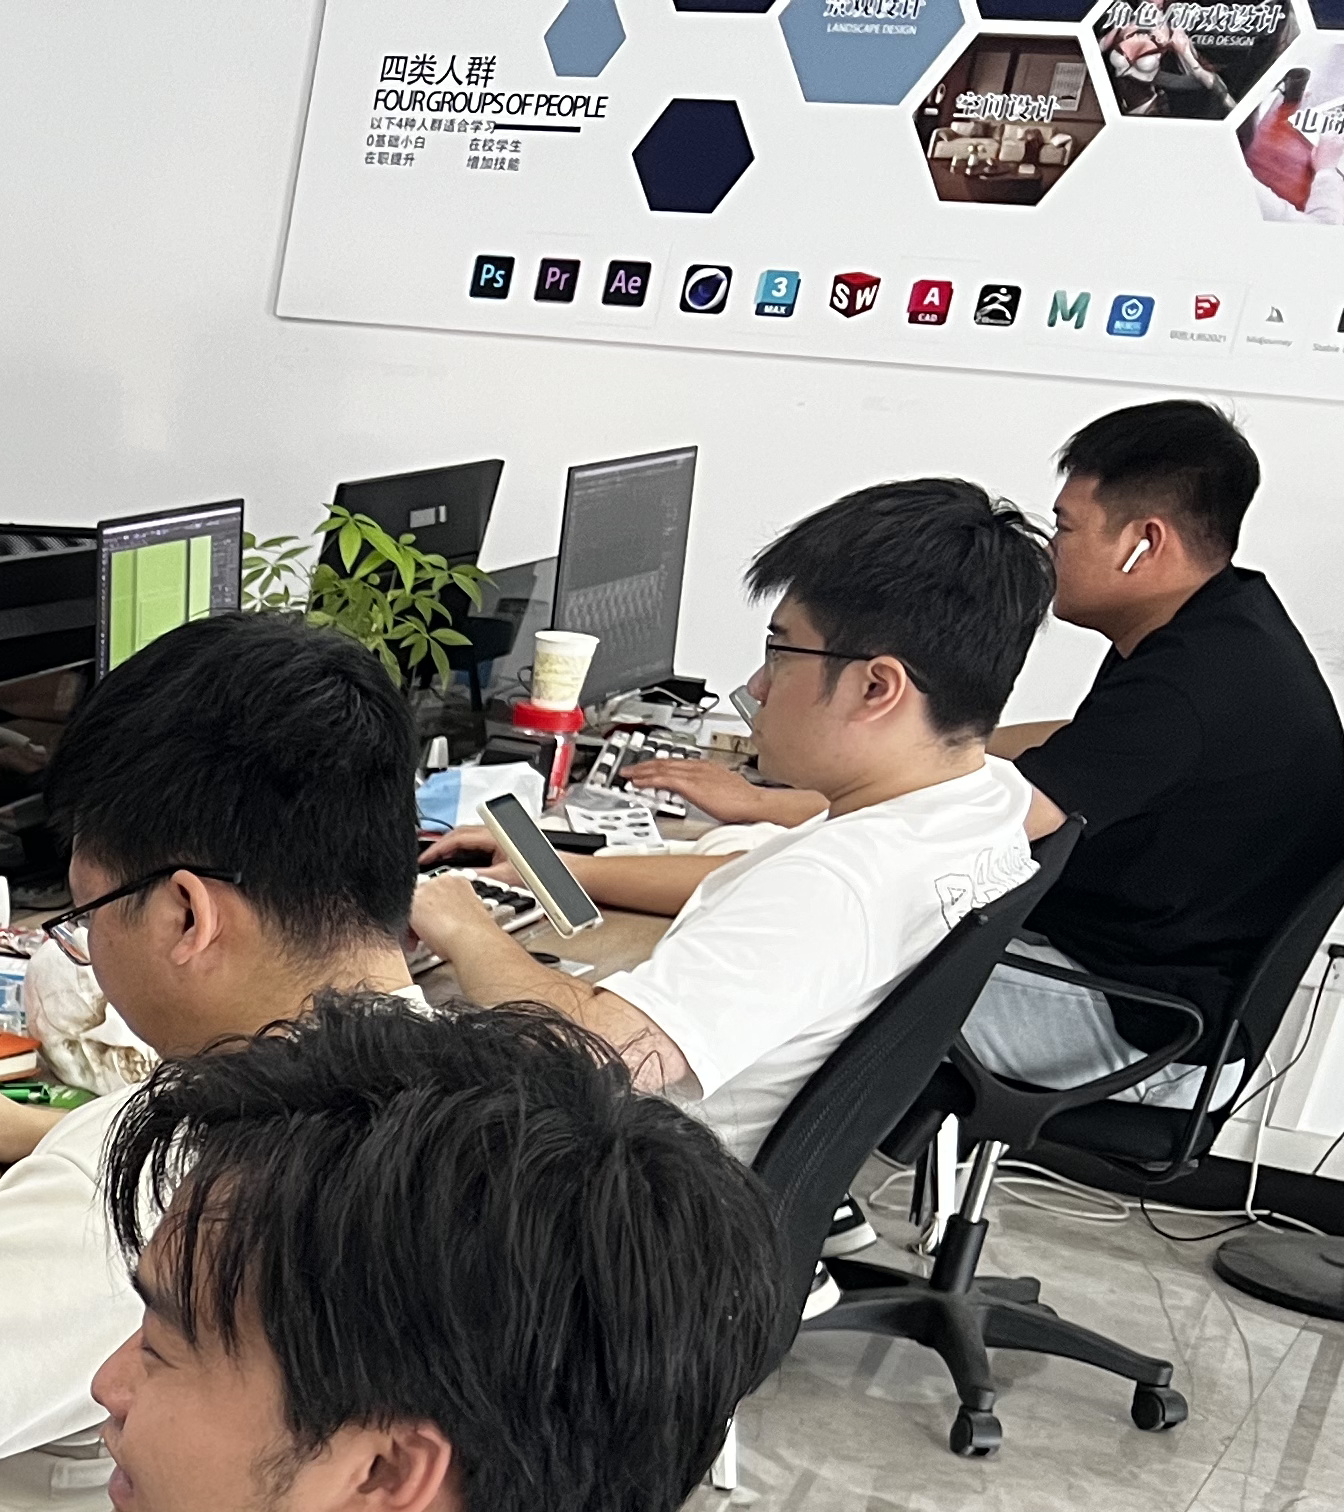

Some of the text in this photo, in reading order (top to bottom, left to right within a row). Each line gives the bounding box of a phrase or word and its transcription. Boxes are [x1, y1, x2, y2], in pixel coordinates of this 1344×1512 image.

[827, 23, 917, 35] LANDSCAPE DESIGN
[1216, 35, 1255, 46] DESIGN
[380, 54, 496, 87] 四类人群
[373, 89, 609, 118] FOUR GROUPS OF PEOPLE
[953, 92, 1061, 122] 空间设计
[370, 117, 496, 134] 以下4种人群适合学习
[366, 134, 426, 149] 0基础小白
[468, 138, 522, 153] 在校学生
[480, 264, 505, 288] Ps
[545, 266, 571, 291] Pr
[609, 269, 642, 294] Ae
[771, 277, 789, 298] 3
[832, 283, 879, 311] SW
[923, 287, 941, 306] A
[917, 312, 938, 323] CAD
